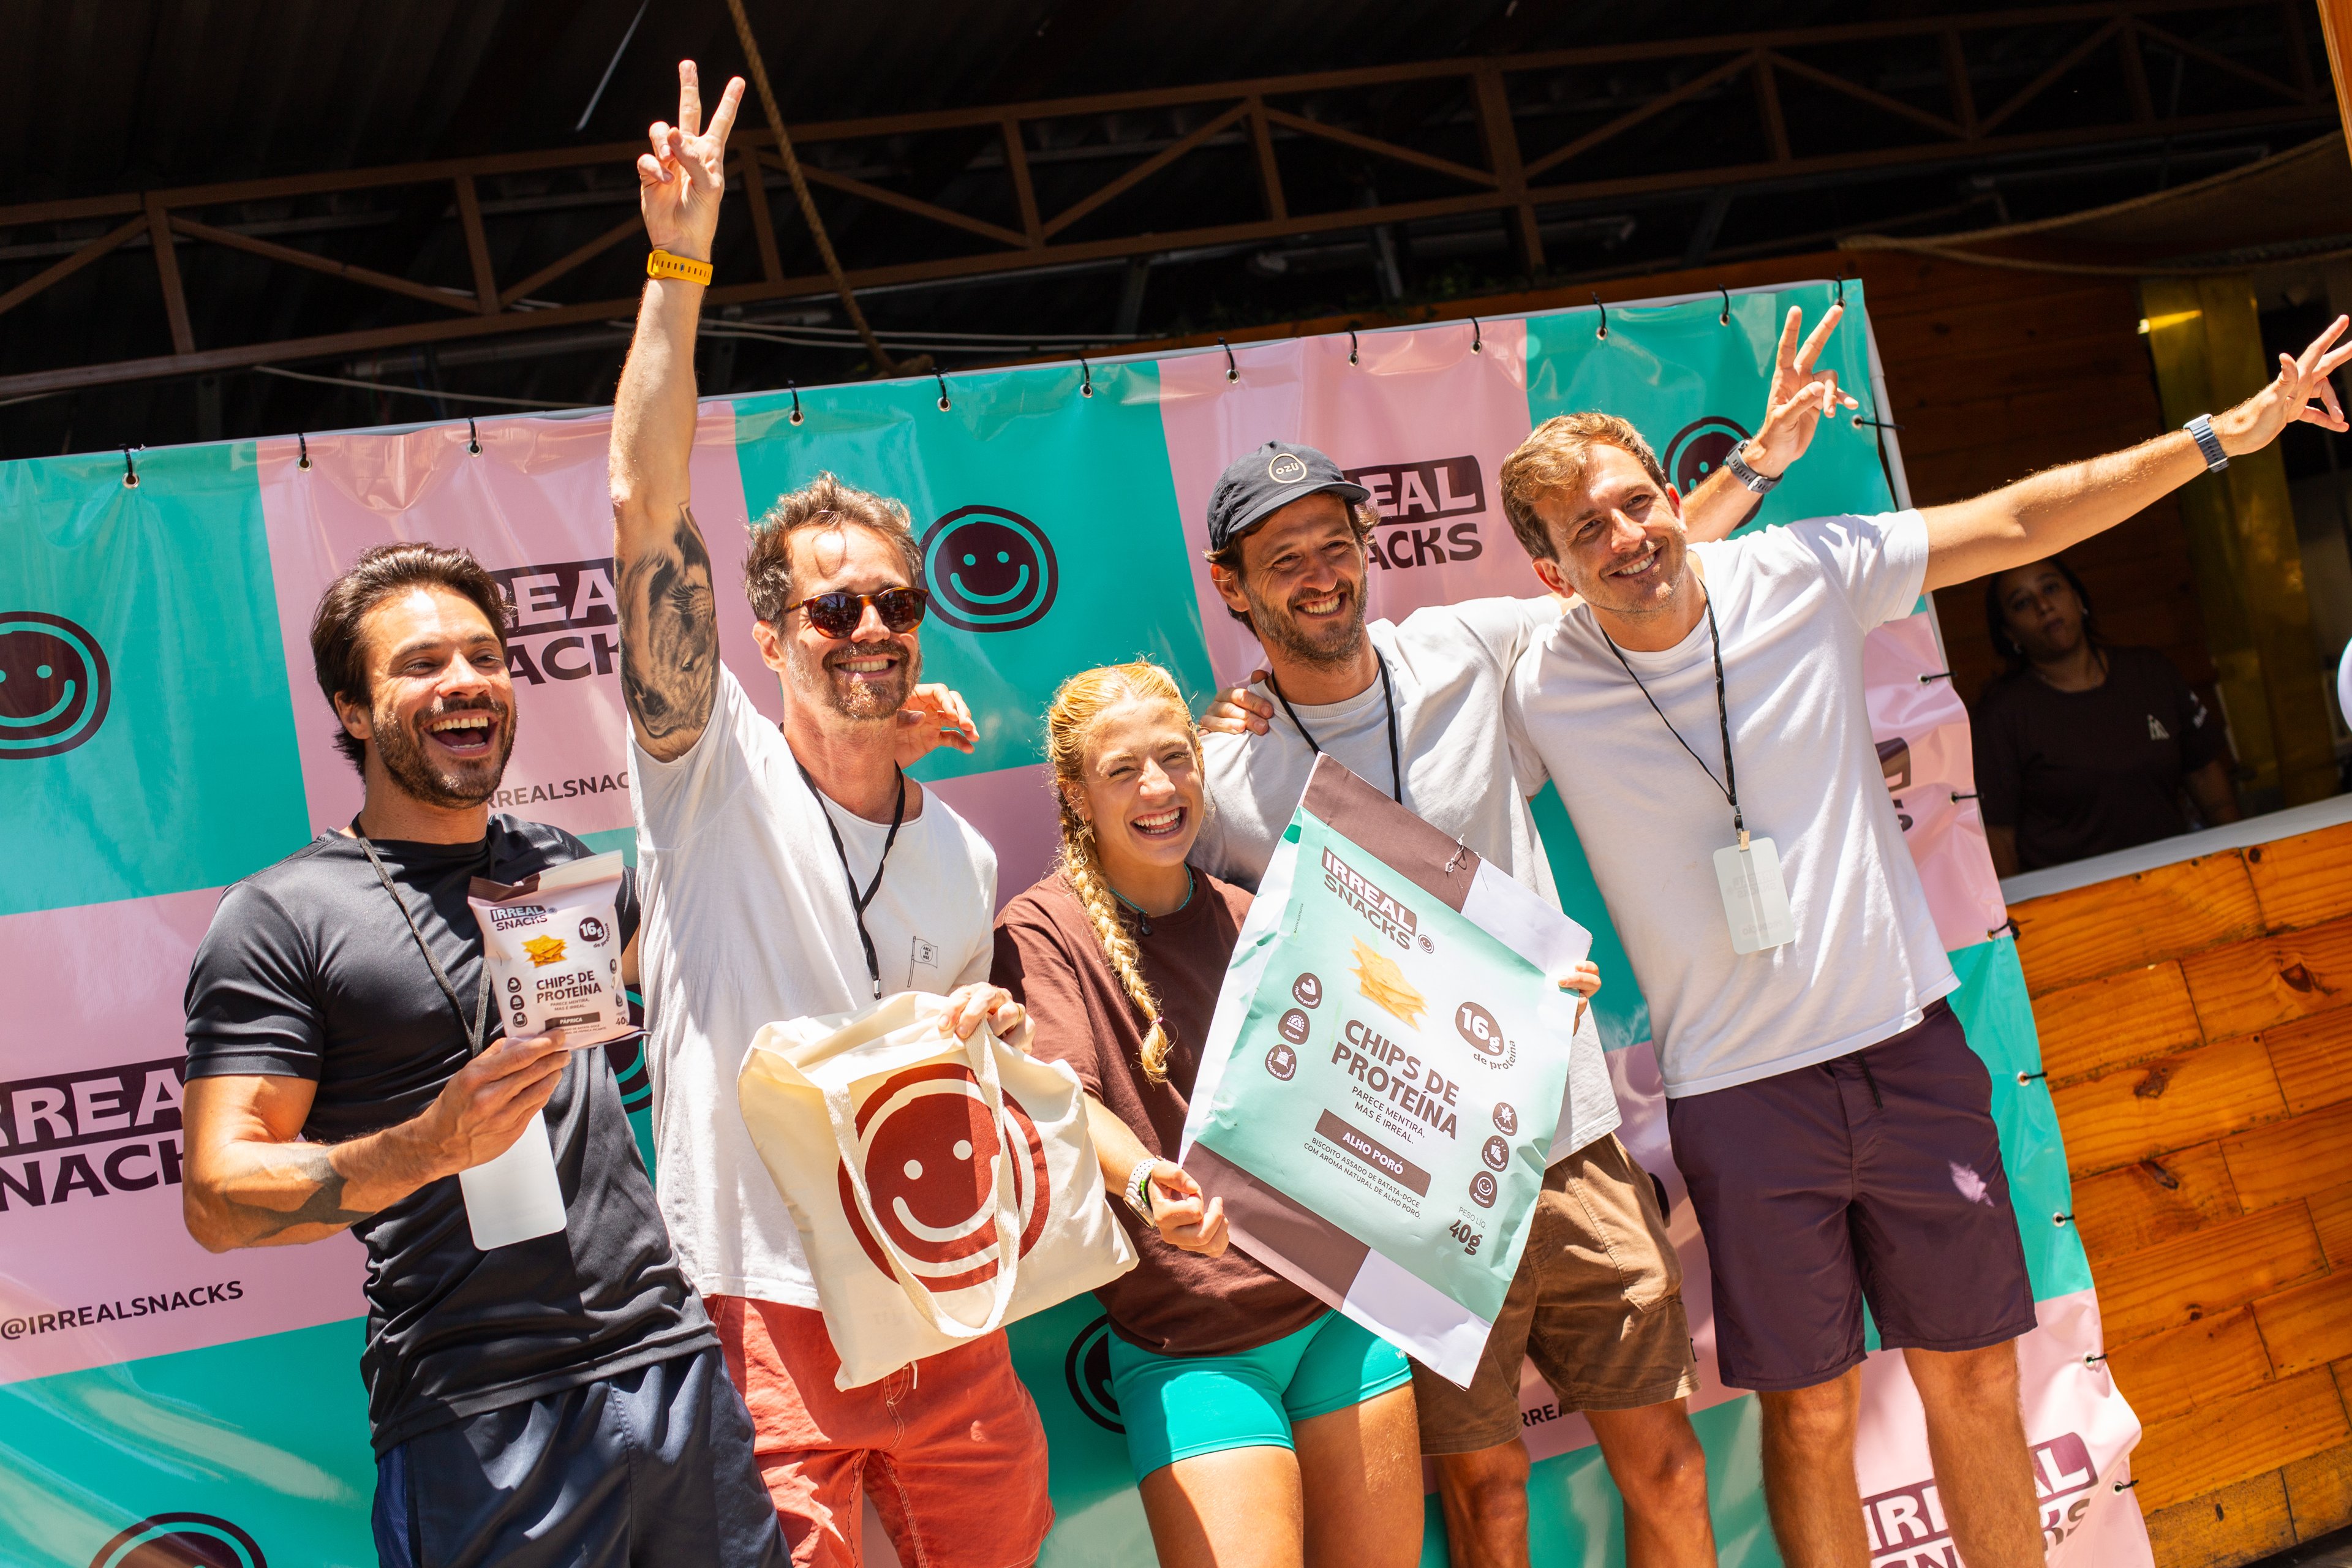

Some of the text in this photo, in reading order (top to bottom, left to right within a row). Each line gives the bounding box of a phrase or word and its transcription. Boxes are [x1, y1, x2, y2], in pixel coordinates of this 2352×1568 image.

[1357, 466, 1477, 517] EAL
[492, 907, 545, 921] IRREAL
[1324, 873, 1411, 951] SNACKS
[1325, 851, 1414, 933] IRREAL
[496, 915, 548, 931] SNACKS
[580, 922, 603, 938] 16g
[537, 974, 575, 990] CHIPS
[578, 970, 595, 984] DE
[537, 982, 602, 1004] PROTEÍNA
[1461, 1006, 1501, 1054] 16g
[1345, 1019, 1460, 1107] CHIPS DE
[1473, 1040, 1516, 1070] de proteína
[1331, 1041, 1457, 1140] PROTEÍNA
[1352, 1086, 1425, 1139] PARECE MENTIRA,
[1354, 1101, 1414, 1145] MAS É IRREAL.
[1311, 1137, 1420, 1208] BISCOITO ASSADO DE BATATA-DOCE
[1342, 1132, 1404, 1175] ALHO PORÓ
[1304, 1142, 1421, 1219] COM AROMA NATURAL DE ALHO PORÓ.
[1449, 1219, 1483, 1256] 40g
[1458, 1207, 1487, 1230] PESO LÍQ.
[0, 1280, 244, 1340] @IRREALSNACKS
